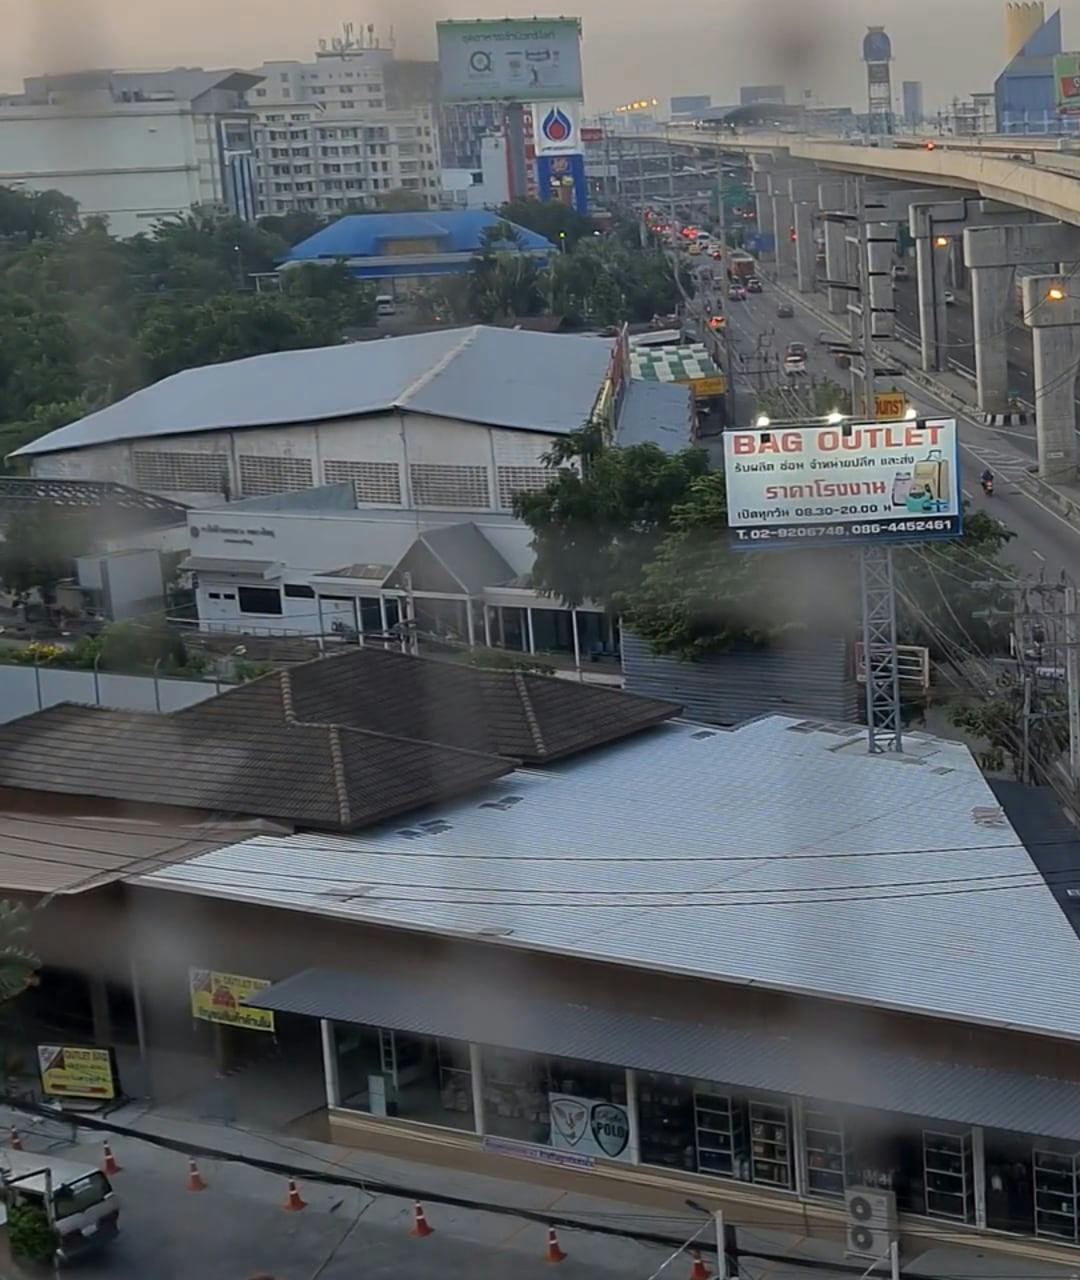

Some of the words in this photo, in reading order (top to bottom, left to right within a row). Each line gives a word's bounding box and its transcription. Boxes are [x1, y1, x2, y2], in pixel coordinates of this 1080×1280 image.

[733, 431, 803, 455] BAG
[818, 425, 945, 451] OUTLET
[766, 479, 887, 500] ราคาโรงงาน
[596, 1121, 625, 1138] POLO
